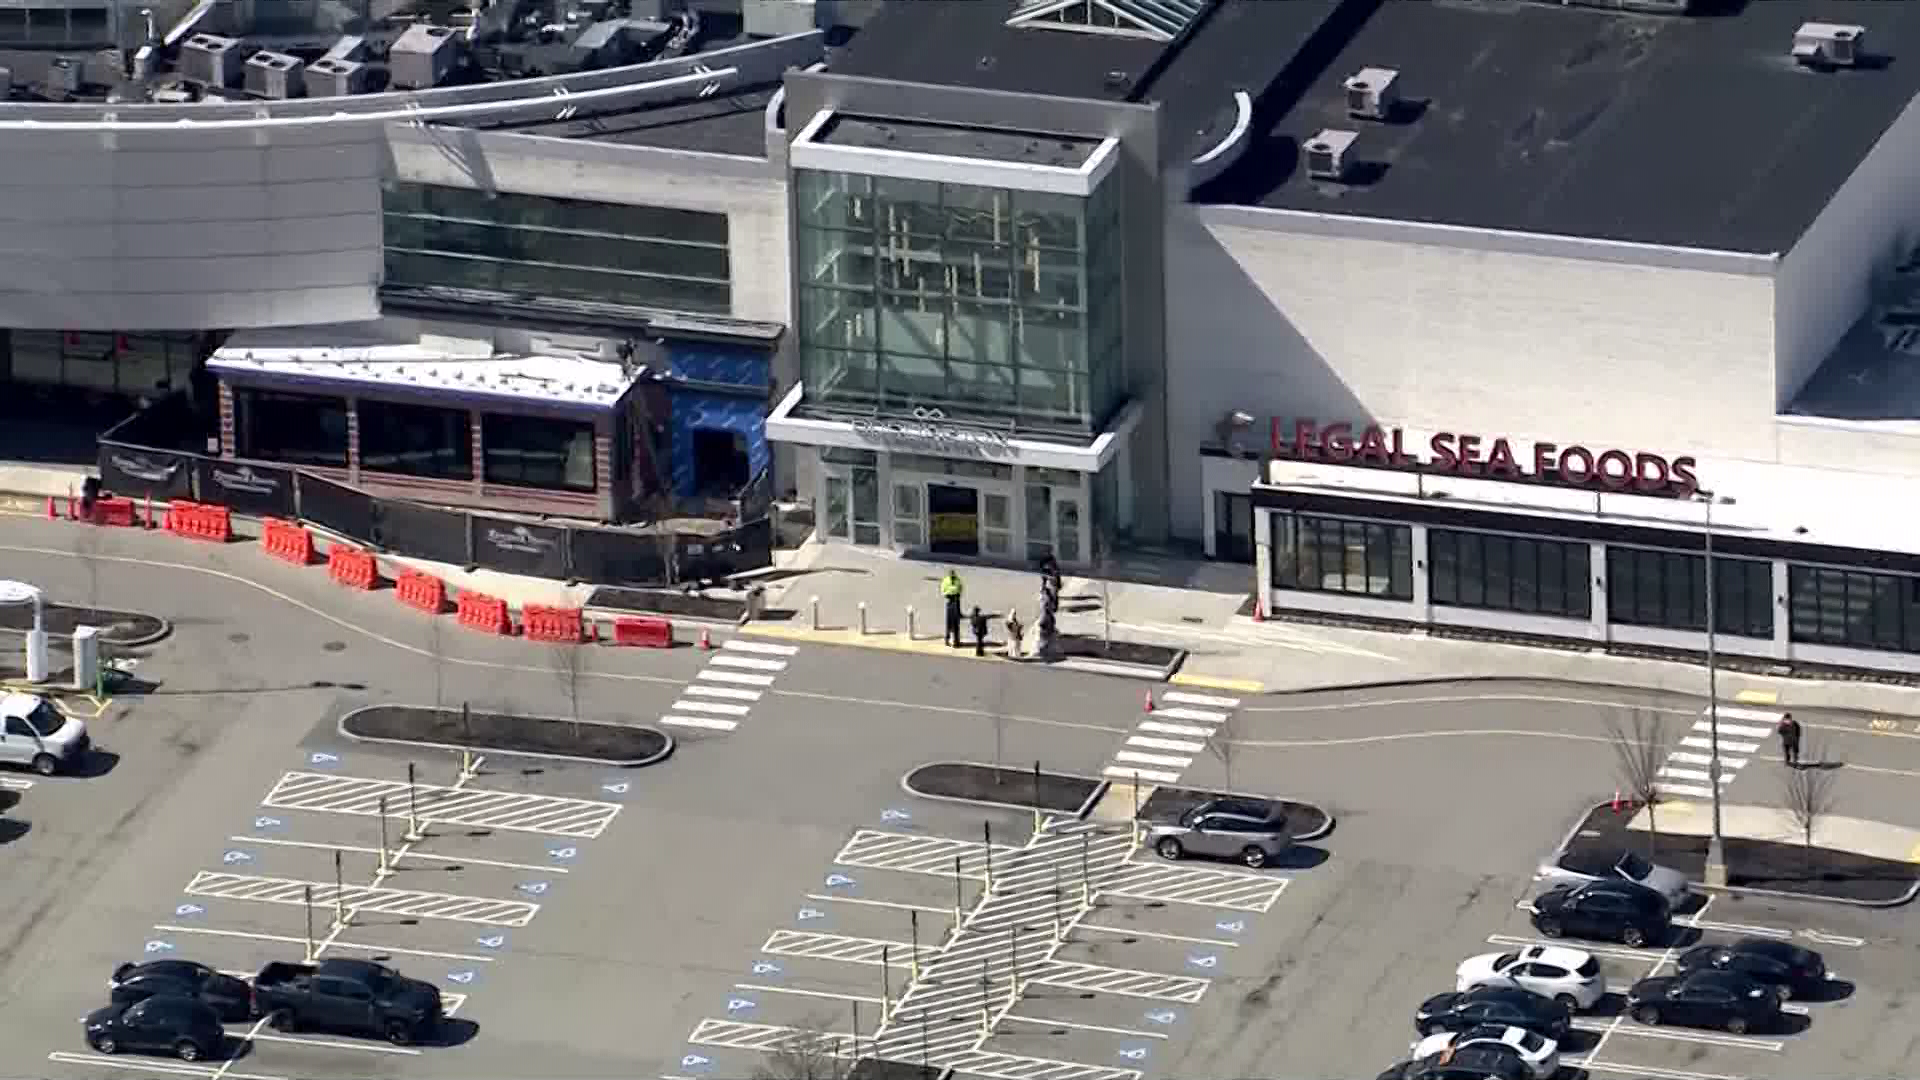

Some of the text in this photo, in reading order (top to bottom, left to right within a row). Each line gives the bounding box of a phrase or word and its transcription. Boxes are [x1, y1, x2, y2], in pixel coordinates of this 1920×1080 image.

[1270, 416, 1698, 499] LEGAL SEA FOODS
